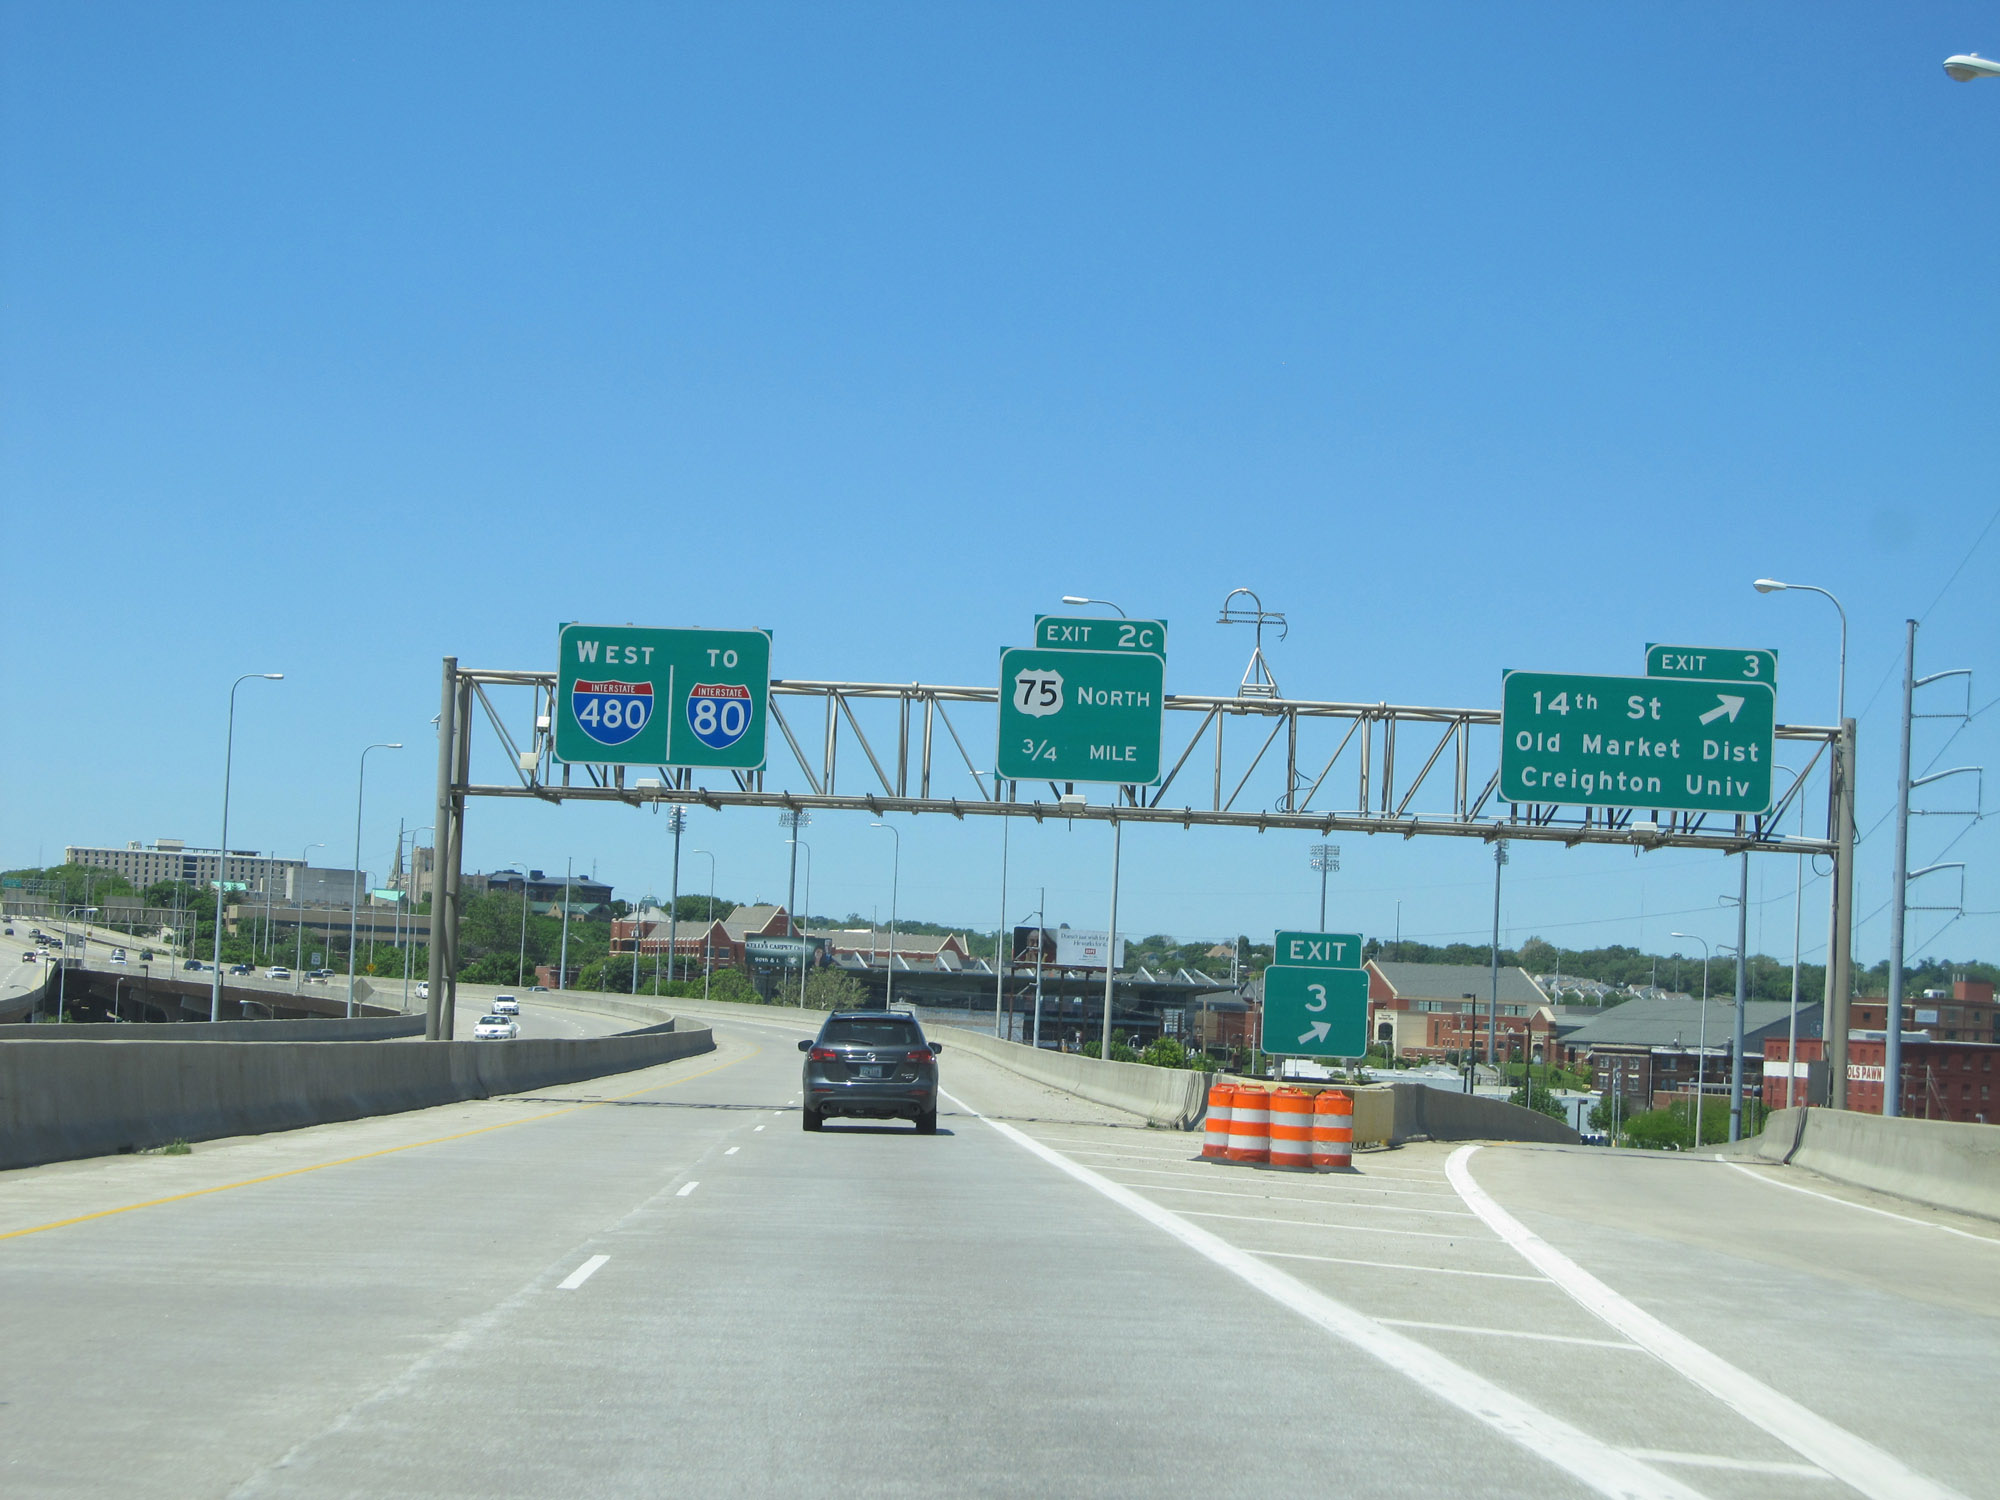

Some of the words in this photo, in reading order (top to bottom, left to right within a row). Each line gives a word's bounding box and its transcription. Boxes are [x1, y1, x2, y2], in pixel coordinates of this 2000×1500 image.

[1047, 625, 1092, 642] EXIT
[1118, 624, 1154, 648] 2C
[577, 640, 655, 665] WEST
[707, 649, 739, 668] TO
[1662, 654, 1707, 671] EXIT
[1743, 655, 1760, 677] 3
[591, 683, 636, 694] INTERSTATE
[698, 687, 743, 698] INTERSTATE
[1019, 679, 1057, 707] 75
[1078, 687, 1150, 707] NORTH
[579, 699, 646, 730] 480
[694, 700, 746, 736] 80
[1533, 691, 1598, 716] 14th
[1627, 696, 1662, 720] St
[1022, 739, 1058, 762] 3/4
[1090, 745, 1137, 762] MILE
[1516, 731, 1561, 753] Old
[1583, 734, 1681, 759] Market
[1703, 740, 1759, 762] Dist
[1521, 766, 1661, 796] Creighton
[1686, 774, 1750, 797] Univ
[1290, 940, 1347, 961] EXIT
[1305, 984, 1327, 1012] 3
[1862, 1066, 1882, 1080] PAWN
